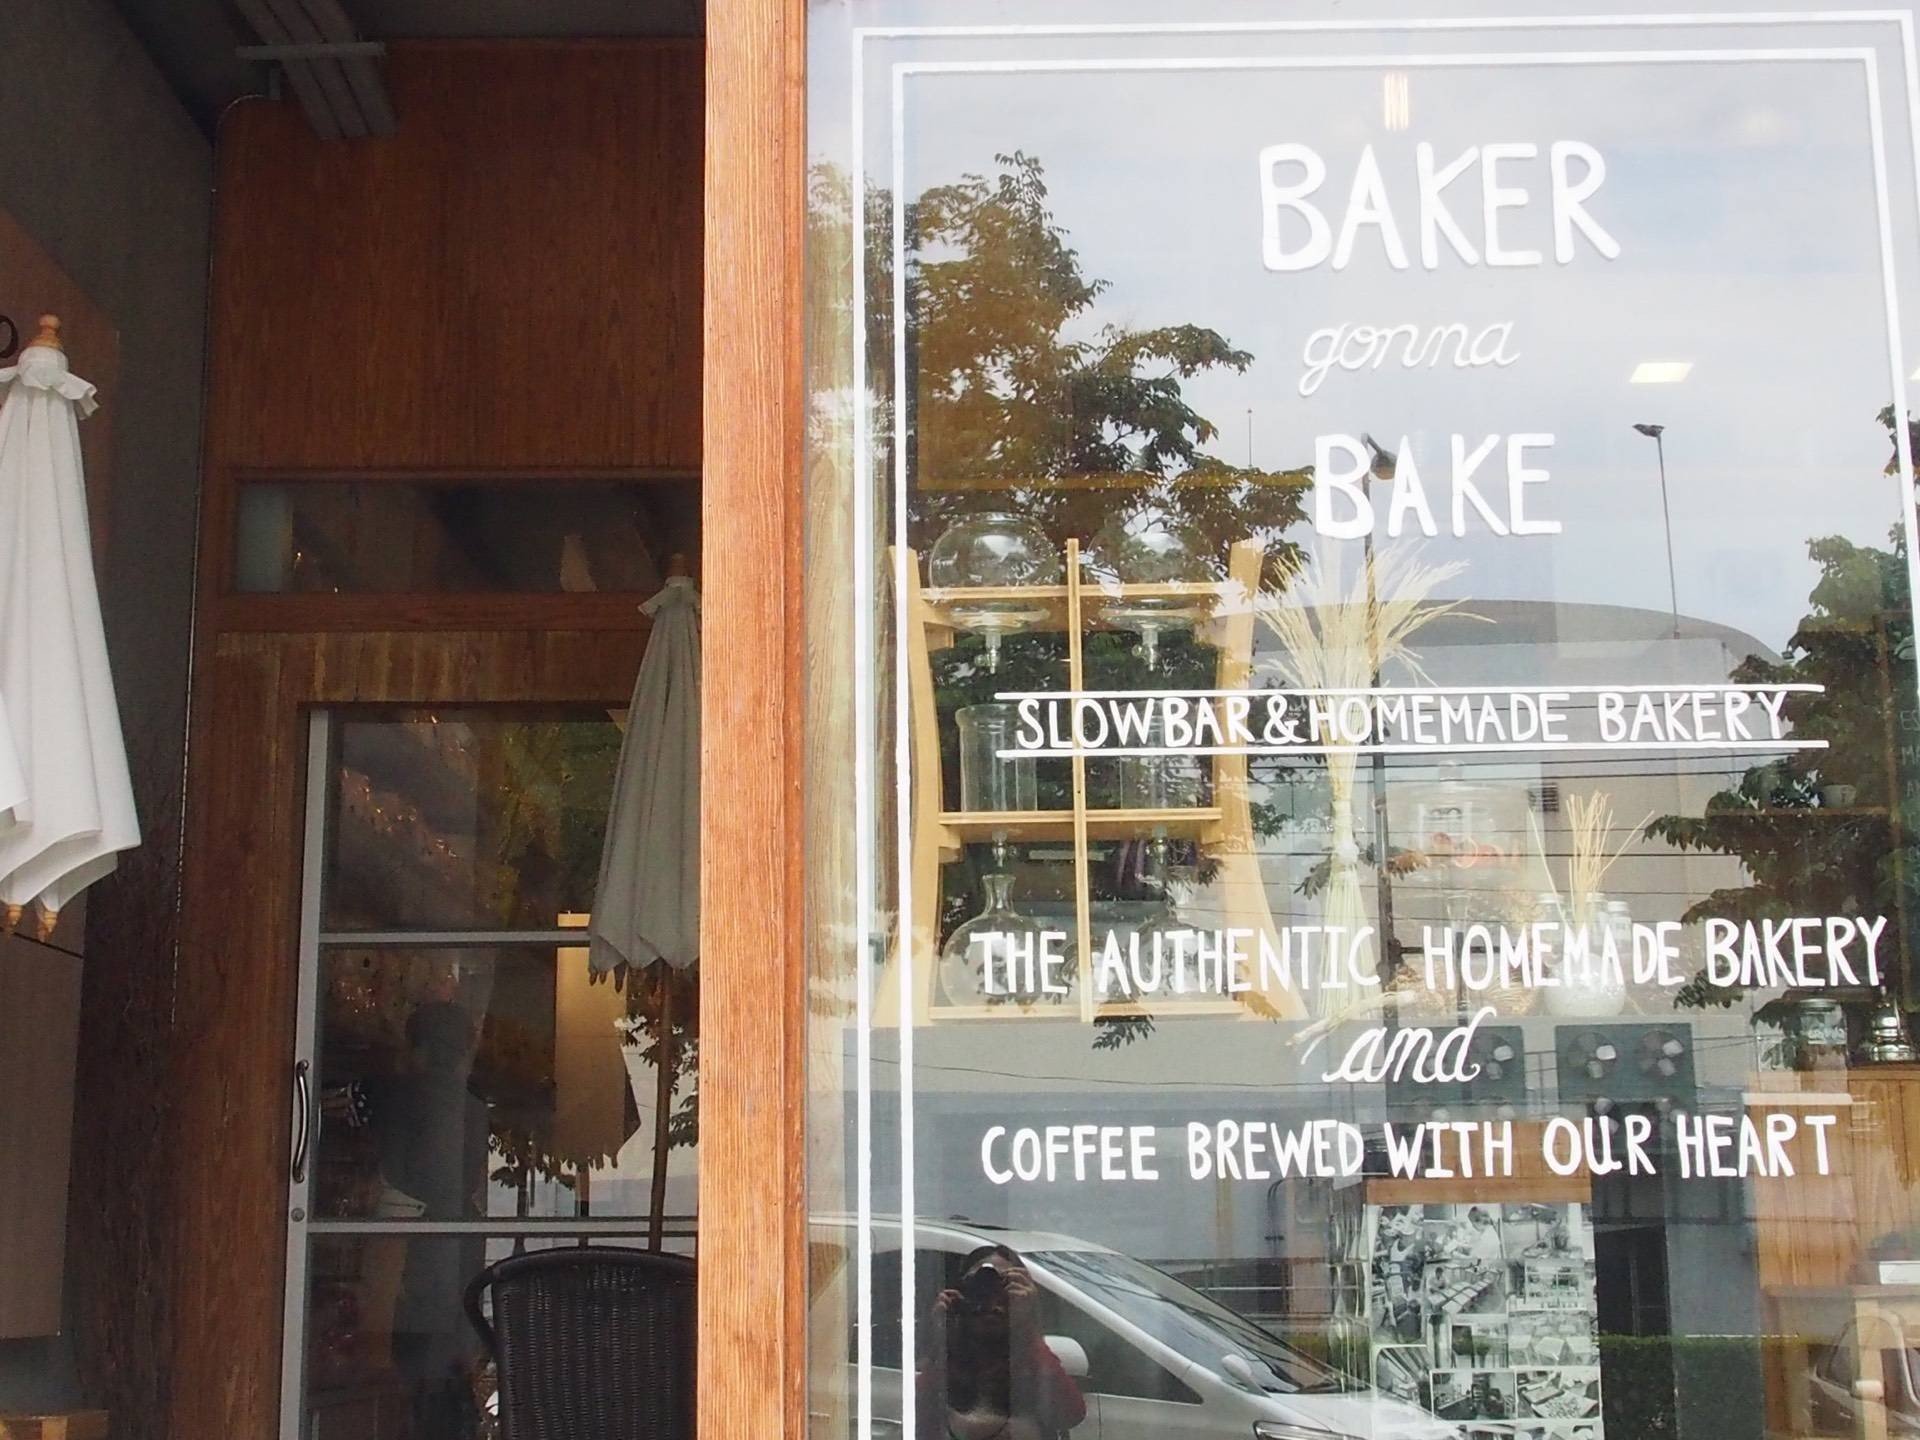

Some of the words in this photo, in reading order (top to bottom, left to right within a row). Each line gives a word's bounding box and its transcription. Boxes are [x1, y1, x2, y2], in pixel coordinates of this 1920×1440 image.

[1259, 140, 1621, 272] BAKER
[1298, 319, 1521, 397] gonna
[1314, 432, 1563, 538] BAKE
[1599, 691, 1787, 742] BAKERY
[969, 930, 1068, 995] THE
[1096, 926, 1382, 995] AUTHENTIC
[1423, 921, 1685, 991] HOMEMADE
[1705, 914, 1887, 988] BAKERY
[1321, 1006, 1497, 1083] and
[981, 1124, 1159, 1184] COFFEE
[1187, 1119, 1365, 1181] BREWED
[1384, 1121, 1512, 1181] WITH
[1543, 1115, 1656, 1178] OUR
[1676, 1114, 1837, 1179] HEART
